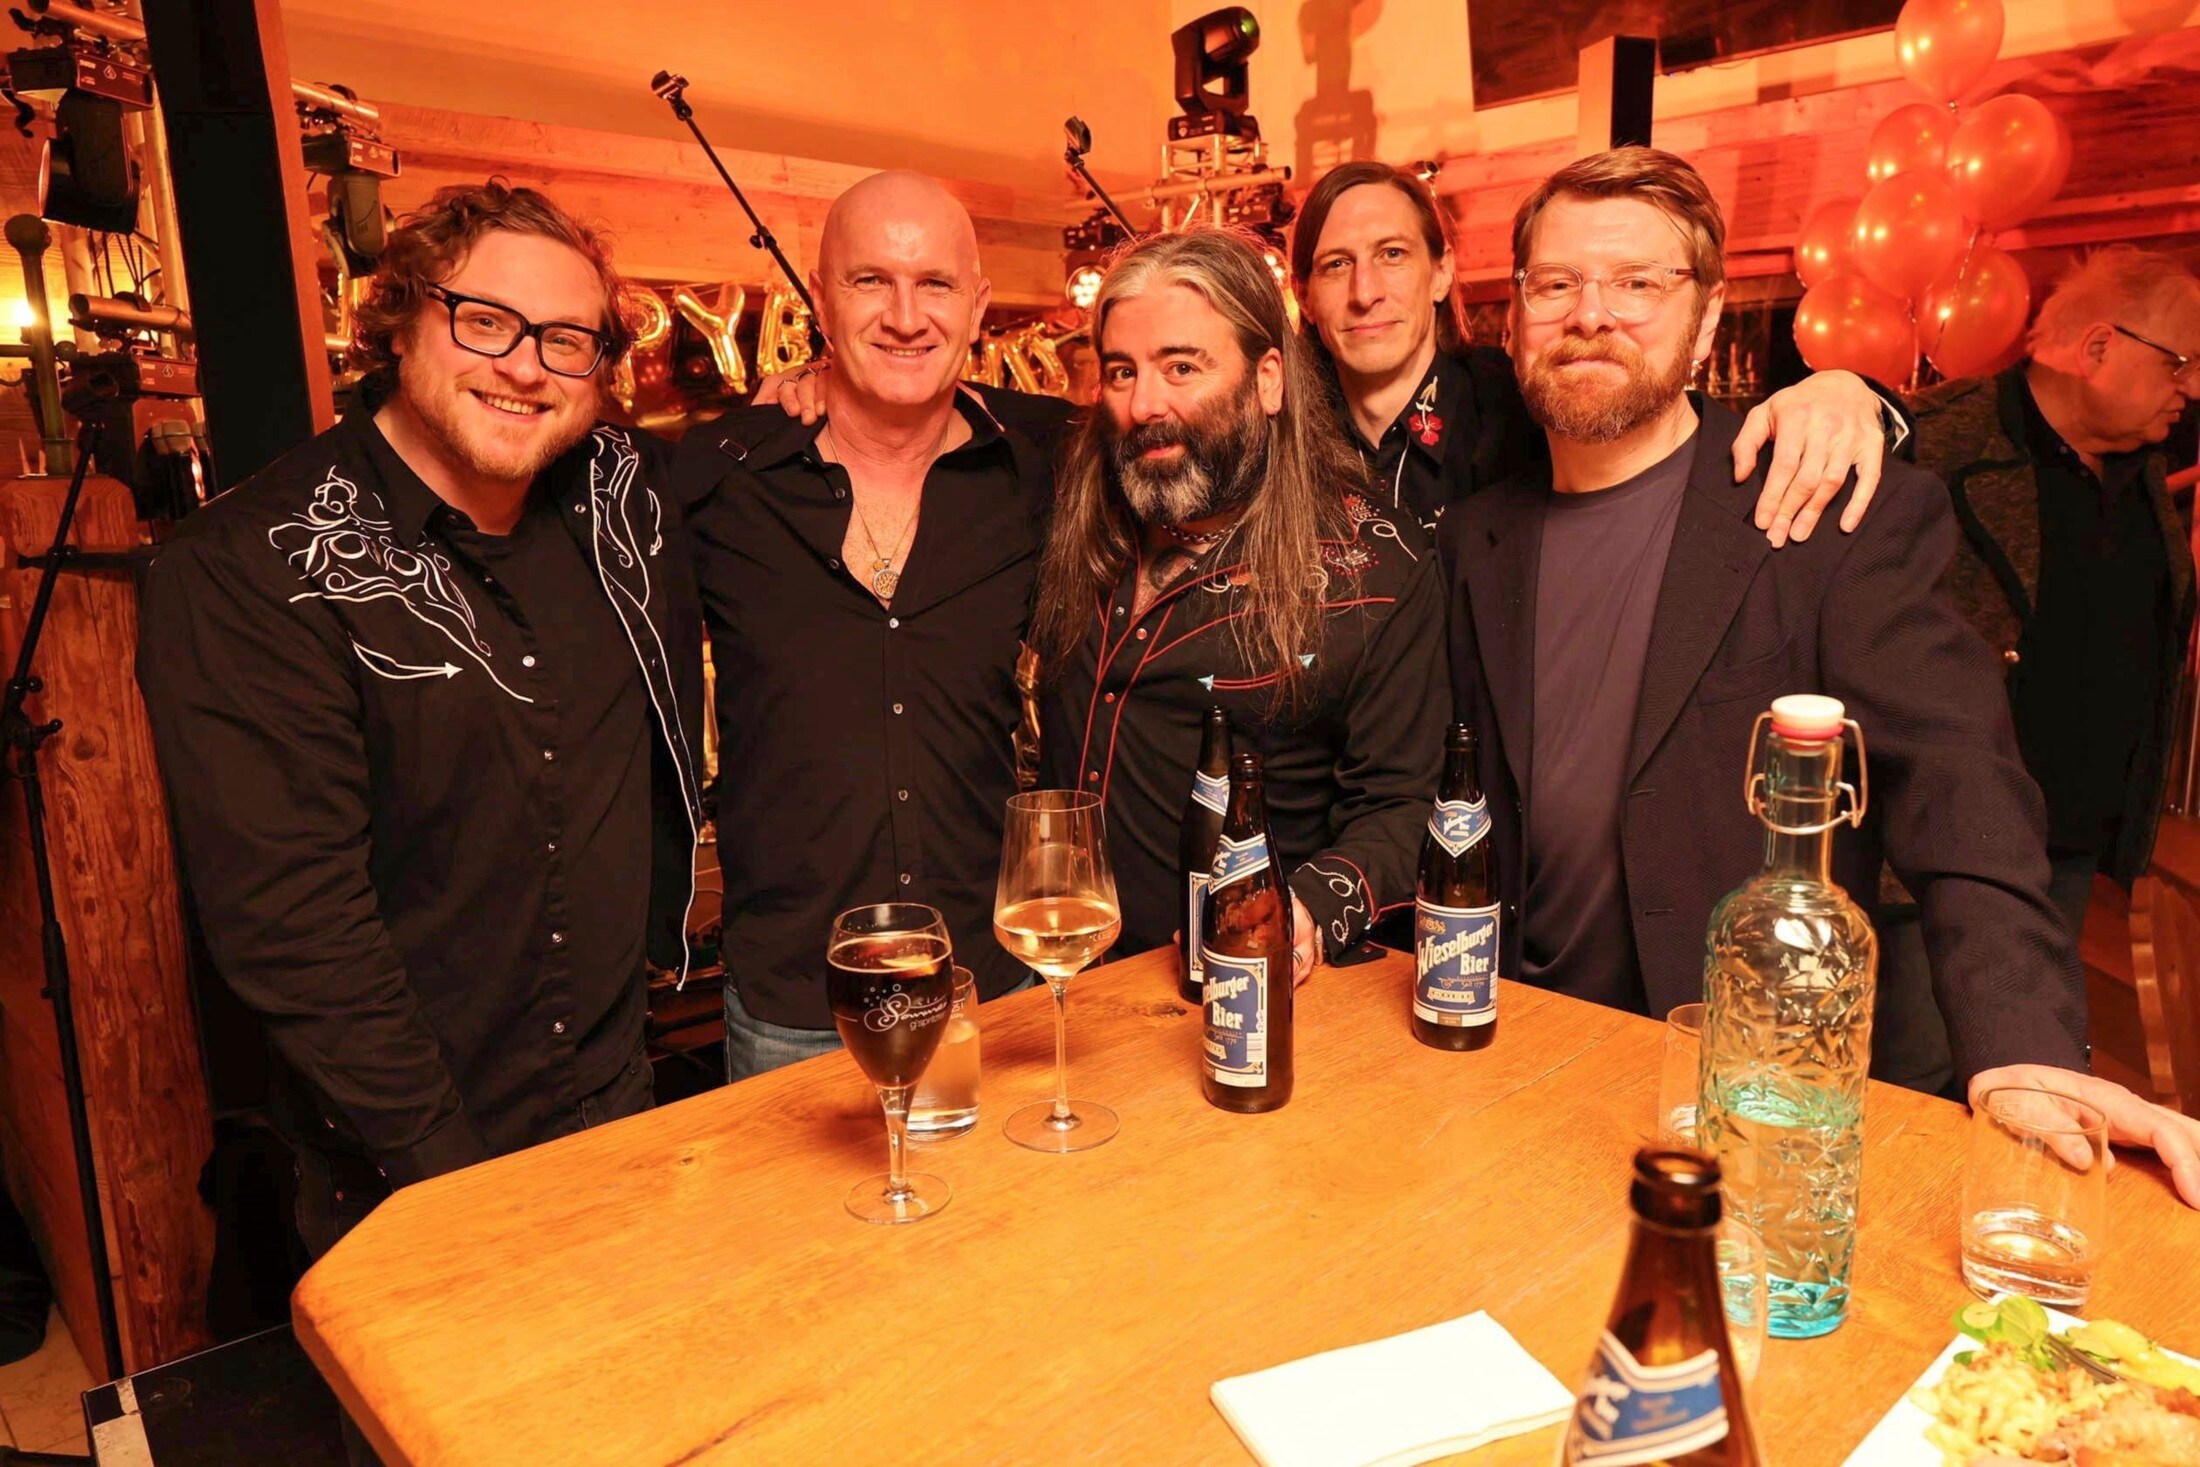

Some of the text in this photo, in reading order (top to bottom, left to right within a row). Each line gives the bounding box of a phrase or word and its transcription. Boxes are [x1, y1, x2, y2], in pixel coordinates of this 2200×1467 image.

[1417, 921, 1494, 985] Wieselburger
[1460, 952, 1490, 975] Bier
[1212, 1001, 1243, 1030] Bier
